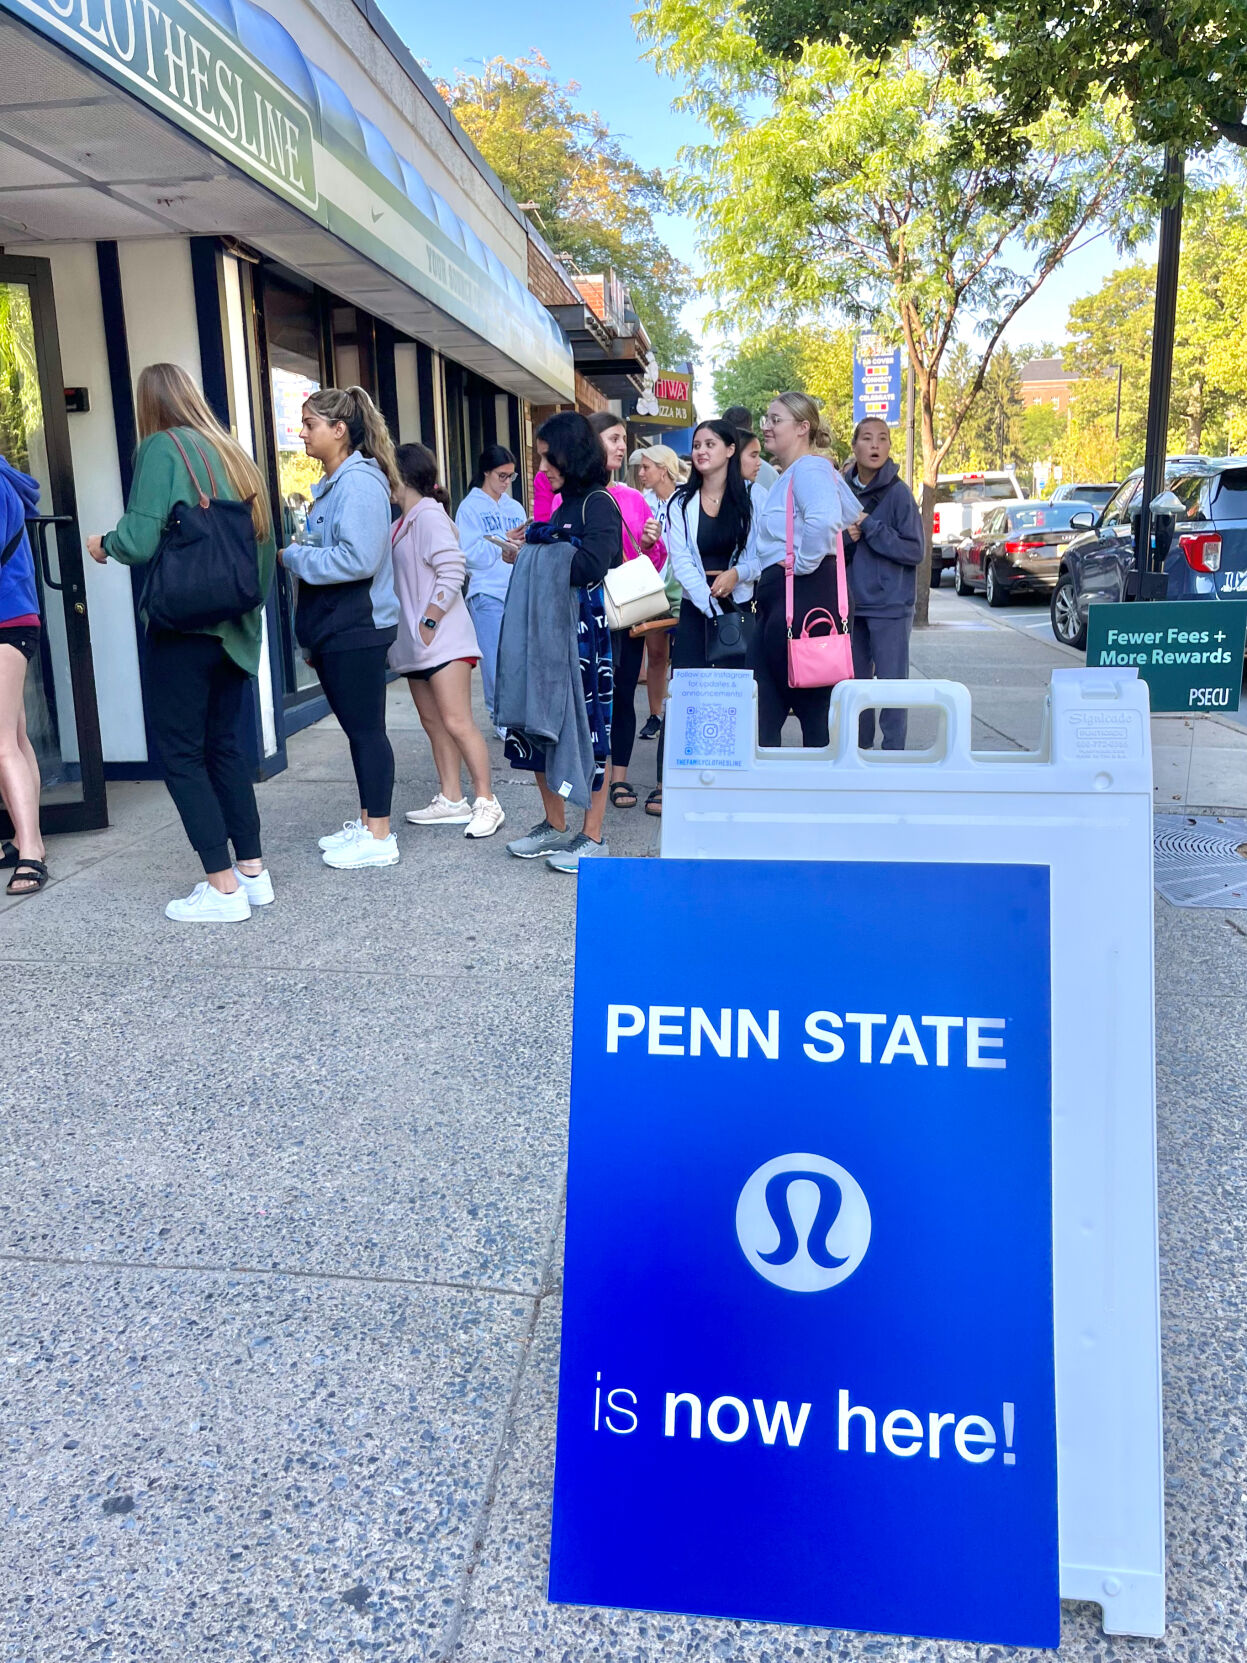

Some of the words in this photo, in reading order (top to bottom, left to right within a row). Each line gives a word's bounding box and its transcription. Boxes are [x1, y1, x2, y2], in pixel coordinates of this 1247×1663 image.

[53, 0, 306, 192] OTHESLINE
[861, 376, 892, 384] CONNECT
[657, 379, 689, 401] HIWAY
[858, 394, 895, 402] CELEBRATE
[1107, 629, 1163, 646] Fewer
[1167, 628, 1209, 644] Fees
[1213, 630, 1227, 643] +
[1100, 650, 1147, 666] More
[1151, 648, 1232, 665] Rewards
[676, 671, 699, 679] Follow
[699, 680, 729, 689] updates
[1188, 687, 1230, 706] PSECU
[606, 1004, 780, 1060] PENN
[803, 1010, 1007, 1069] STATE
[594, 1371, 638, 1434] is
[664, 1392, 811, 1447] now
[838, 1389, 1016, 1466] here!
